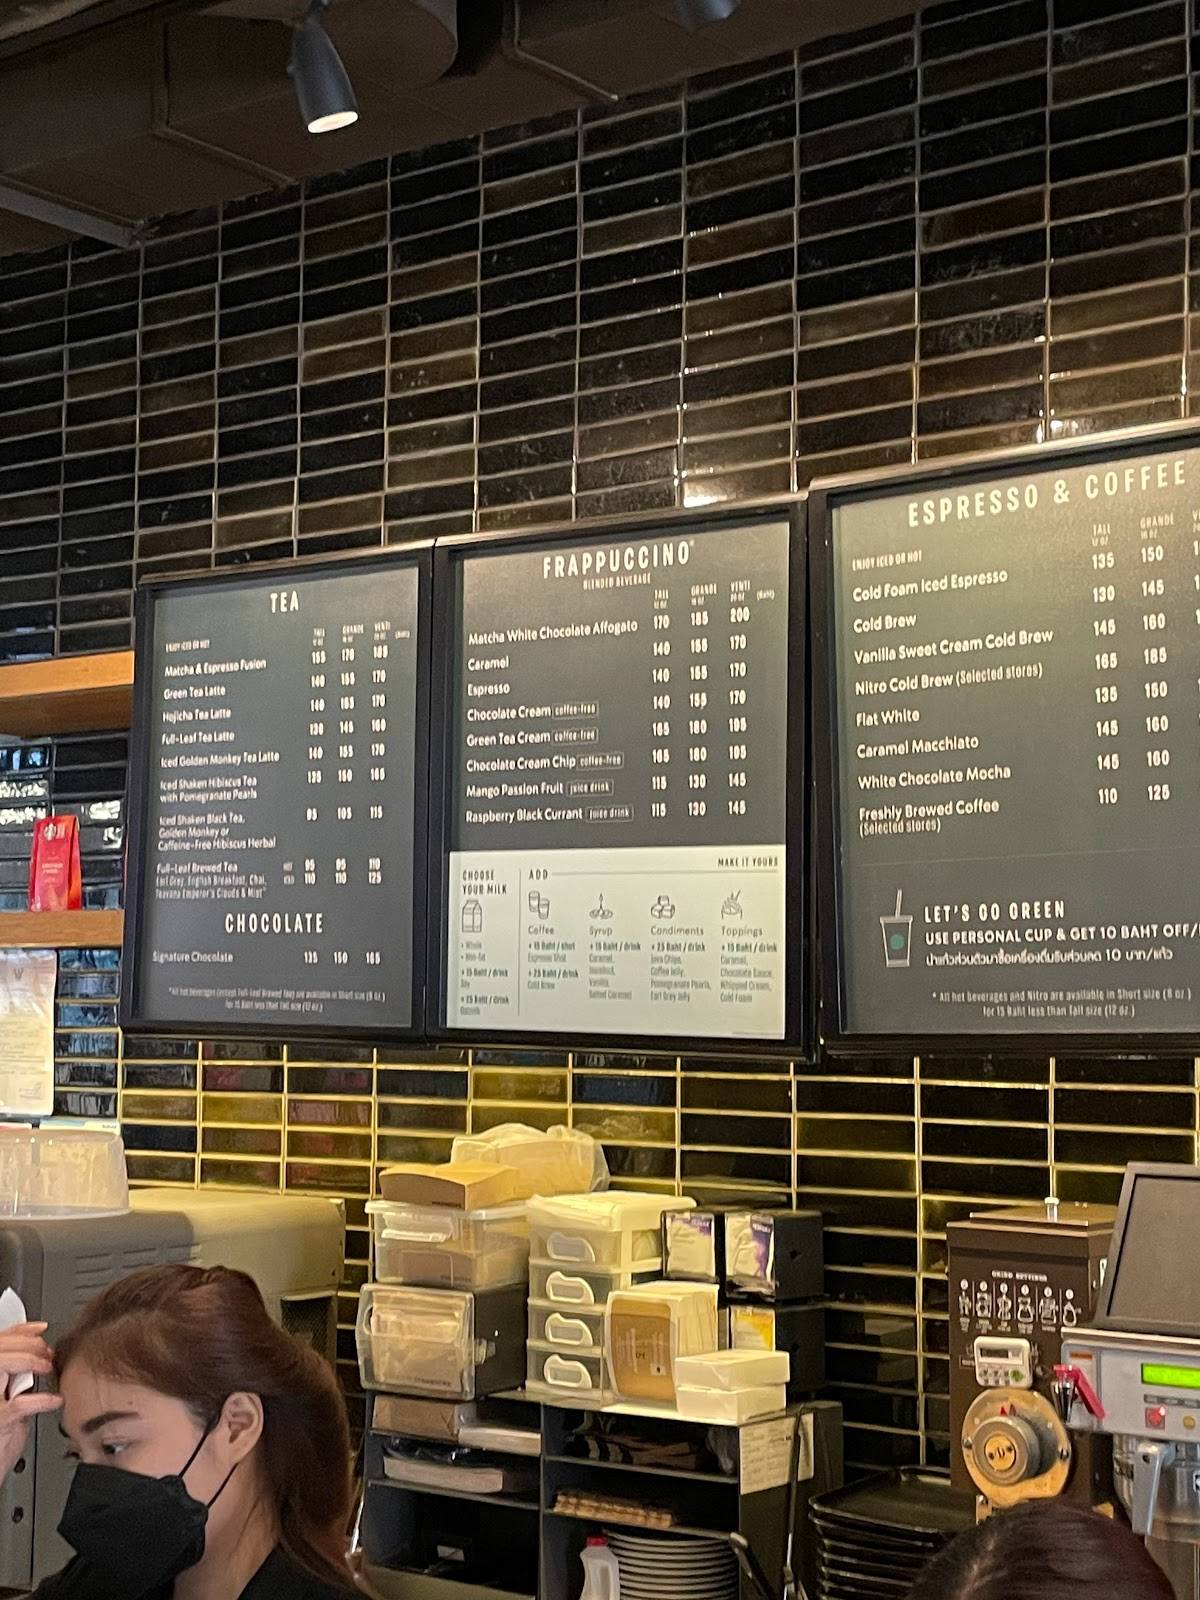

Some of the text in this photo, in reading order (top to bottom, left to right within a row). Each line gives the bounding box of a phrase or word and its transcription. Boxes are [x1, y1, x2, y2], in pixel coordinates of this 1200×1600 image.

[908, 461, 1185, 527] ESPRESSO & COFFEE
[895, 552, 906, 565] OR
[907, 550, 922, 562] HOT
[1092, 545, 1164, 570] 135 150
[853, 570, 1008, 601] Cold Foam Iced Espresso
[1093, 579, 1165, 602] 130 145
[270, 590, 299, 613] TEA
[653, 606, 750, 630] 170 200
[853, 614, 917, 633] Cold Brew
[468, 620, 638, 646] Matcha White Chocolate Affogato
[1094, 619, 1116, 636] 145
[653, 634, 747, 656] 140 170
[854, 630, 1054, 664] Vanilla Sweet Cream Cold Brew
[164, 665, 195, 678] Matcha
[204, 662, 240, 675] Espresso
[240, 658, 267, 671] Fusion
[467, 656, 509, 672] Caramel
[652, 662, 746, 683] 140 170
[372, 669, 386, 683] 170
[855, 662, 1044, 696] Nitro Cold Brew (Selected stores)
[163, 685, 226, 700] Green Tea Latte
[467, 682, 511, 698] Espresso
[1096, 686, 1118, 703] 135
[372, 694, 386, 708] 170
[653, 690, 746, 710] 140 170
[162, 708, 232, 724] Hojicha Tea Latte
[467, 706, 517, 722] Chocolate
[518, 705, 552, 719] Cream
[856, 708, 920, 728] Flat White
[198, 731, 213, 744] Tea
[214, 730, 235, 742] Latte
[1096, 719, 1120, 737] 145
[466, 731, 551, 747] Green Tea Cream
[857, 735, 979, 758] Caramel Macchiato
[371, 743, 386, 756] 170
[160, 756, 178, 768] Iced
[210, 752, 242, 767] Monkey
[242, 752, 258, 764] Tea
[258, 751, 280, 763] Latte
[466, 755, 577, 773] Chocolate Cream Chip
[1097, 753, 1120, 771] 145
[242, 775, 258, 787] Tea
[688, 774, 706, 789] 130
[728, 772, 747, 788] 145
[858, 765, 1012, 790] White Chocolate Mocha
[232, 788, 258, 800] Pearls
[466, 784, 500, 800] Mango
[501, 782, 539, 797] Passion
[540, 782, 564, 796] Fruit
[1098, 784, 1170, 804] 110 125
[466, 810, 514, 824] Raspberry
[516, 808, 543, 822] Black
[544, 806, 583, 821] Currant
[688, 801, 706, 816] 130
[728, 800, 746, 816] 145
[859, 799, 1000, 822] Freshly Brewed Coffee
[859, 818, 941, 838] (Selected stores)
[248, 836, 277, 849] Herbal
[718, 857, 739, 868] MAKE
[462, 870, 508, 896] CHOOSE YOUR MILK
[528, 869, 548, 880] ADD
[924, 900, 1065, 923] LET'S GO GREEN
[225, 912, 323, 934] CHOCOLATE
[650, 925, 704, 936] Condiments
[722, 926, 763, 938] Toppings
[926, 931, 949, 946] USE
[952, 929, 1022, 945] PERSONAL
[1025, 928, 1052, 942] CUP
[1056, 927, 1066, 941] &
[1070, 926, 1096, 941] GET
[1100, 925, 1117, 940] 10
[1120, 923, 1158, 940] BAHT
[153, 950, 234, 964] Signature Chocolate
[1106, 948, 1121, 962] 10
